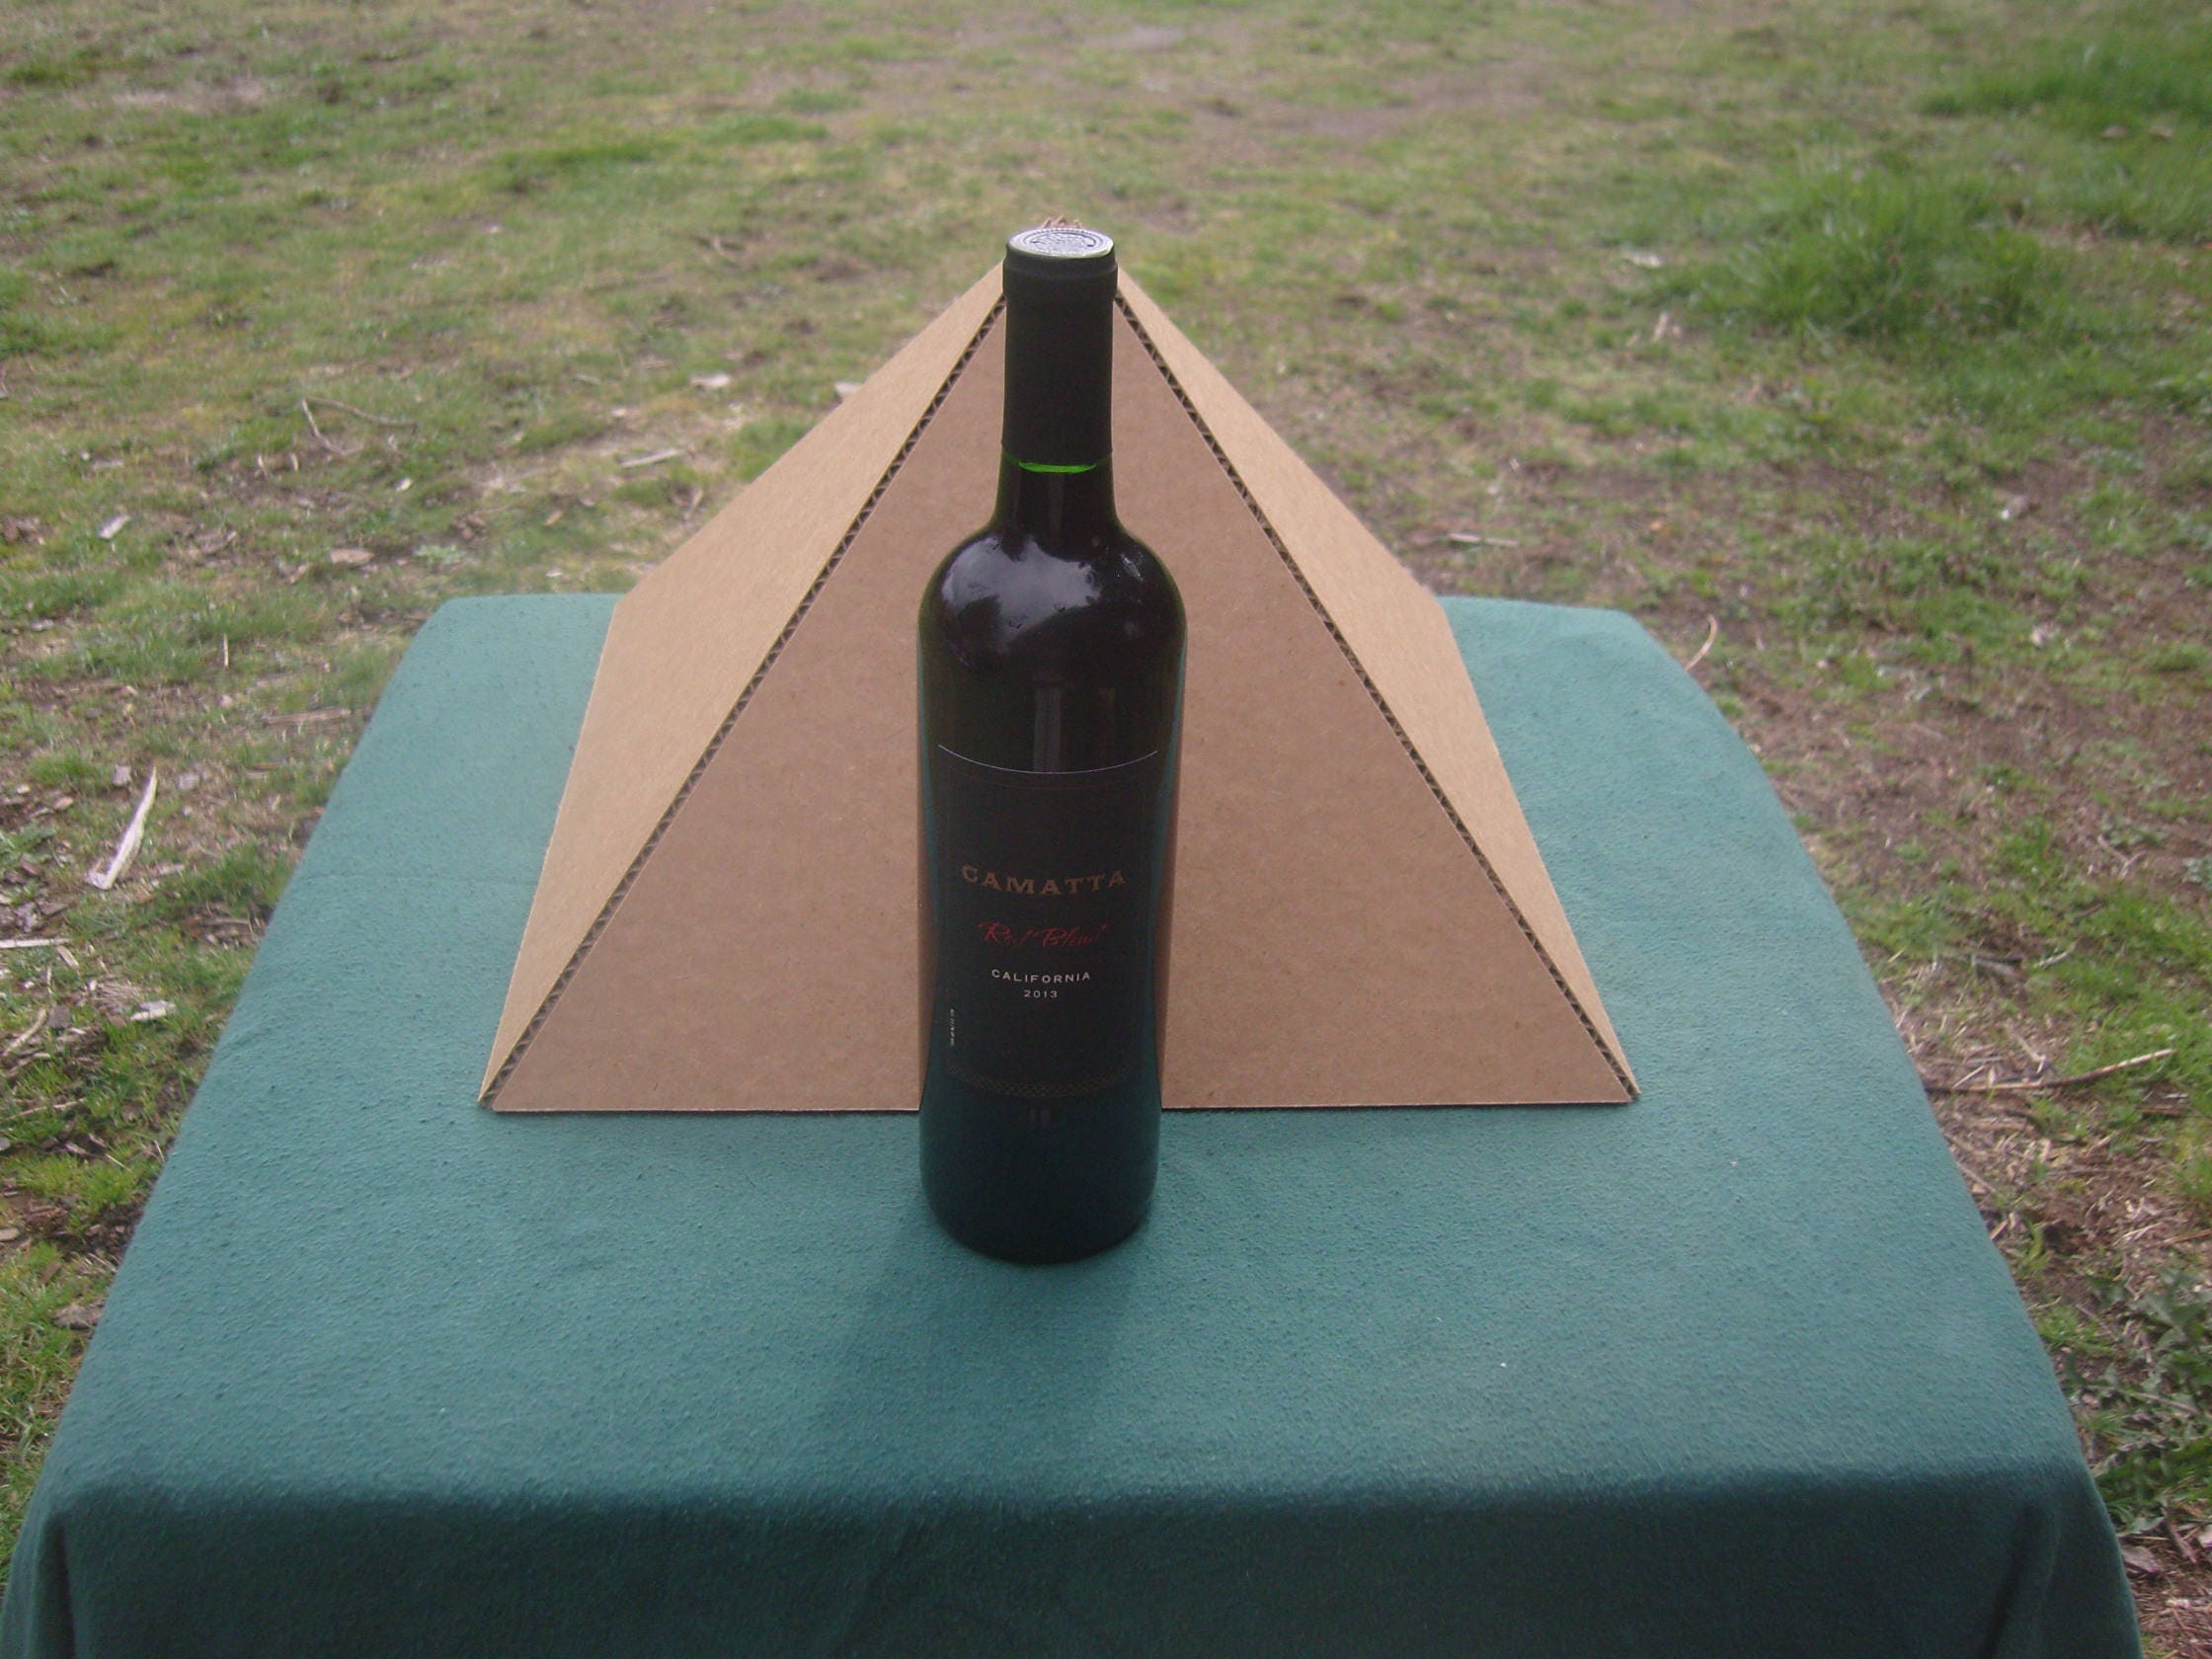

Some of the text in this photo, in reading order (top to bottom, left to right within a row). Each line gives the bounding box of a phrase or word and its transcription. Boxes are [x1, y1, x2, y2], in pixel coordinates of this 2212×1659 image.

[961, 864, 1127, 895] CAMATTA
[978, 920, 1107, 948] Red Blend
[991, 969, 1090, 984] CALIFORNIA
[1023, 989, 1059, 998] 2013
